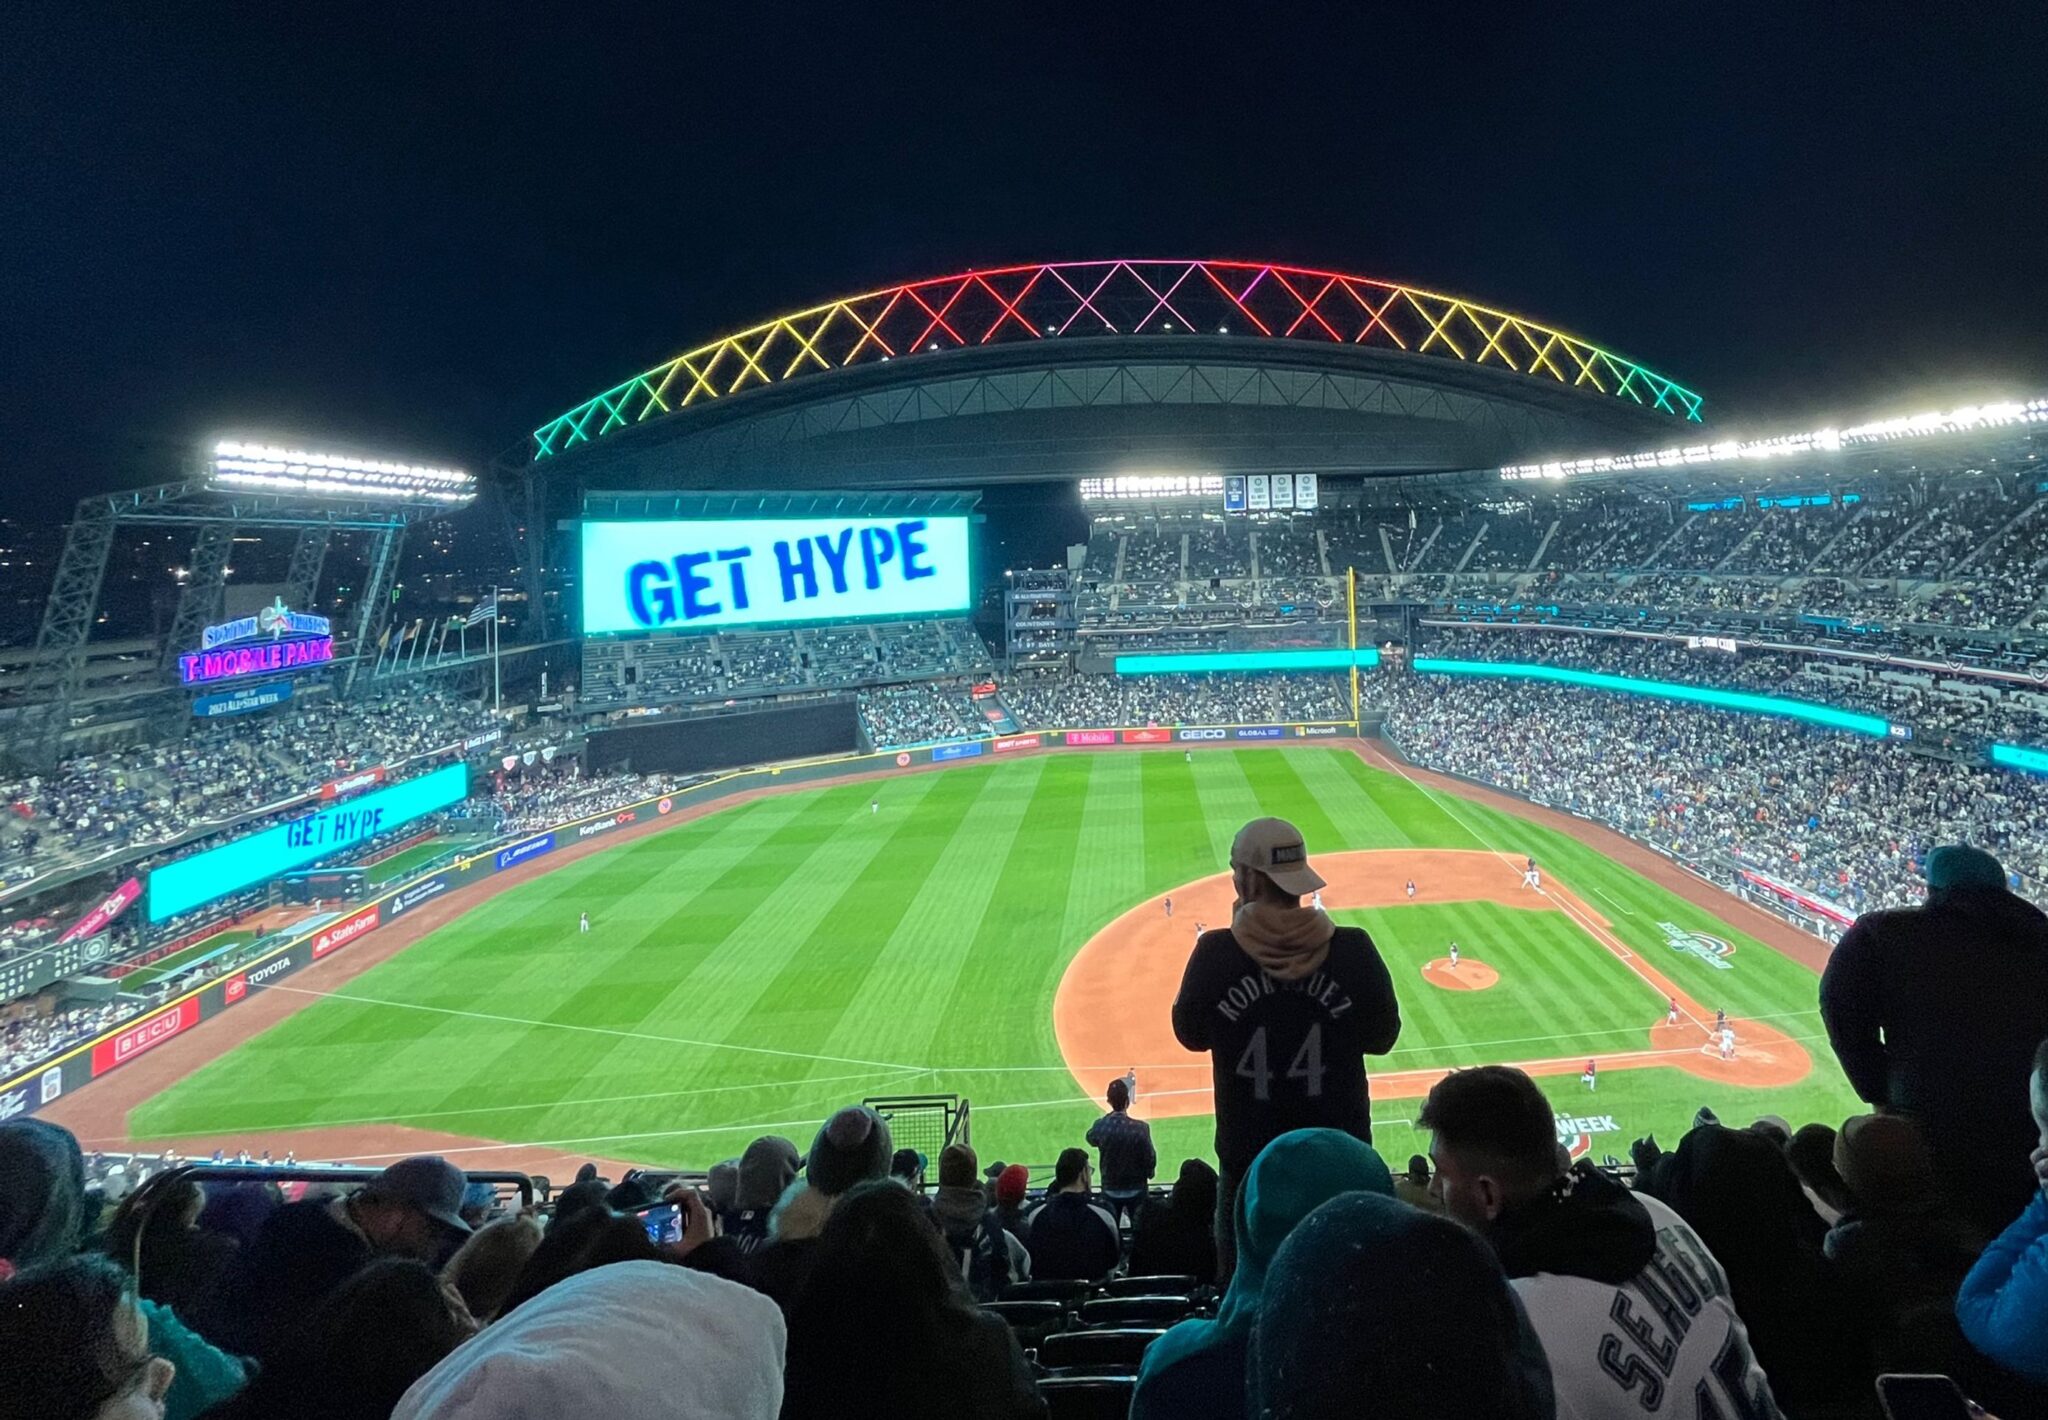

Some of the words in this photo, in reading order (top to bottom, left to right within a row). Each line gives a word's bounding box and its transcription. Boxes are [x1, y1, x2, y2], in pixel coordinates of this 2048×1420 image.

[629, 546, 752, 627] GET
[773, 520, 936, 603] HYPE
[179, 643, 283, 683] T-MOBILE
[282, 635, 334, 668] PARK
[1180, 728, 1226, 740] GEICO
[1238, 729, 1268, 737] GLOBAL
[1305, 726, 1336, 735] Microsoft
[287, 814, 329, 849] GET
[333, 807, 384, 842] HYPE
[579, 817, 617, 837] KeyBank
[248, 956, 291, 985] TOYOTA
[1217, 969, 1353, 1022] RODRUEZ
[120, 1014, 177, 1053] BECU
[1235, 1022, 1327, 1101] 44
[1554, 1115, 1622, 1135] WEEK
